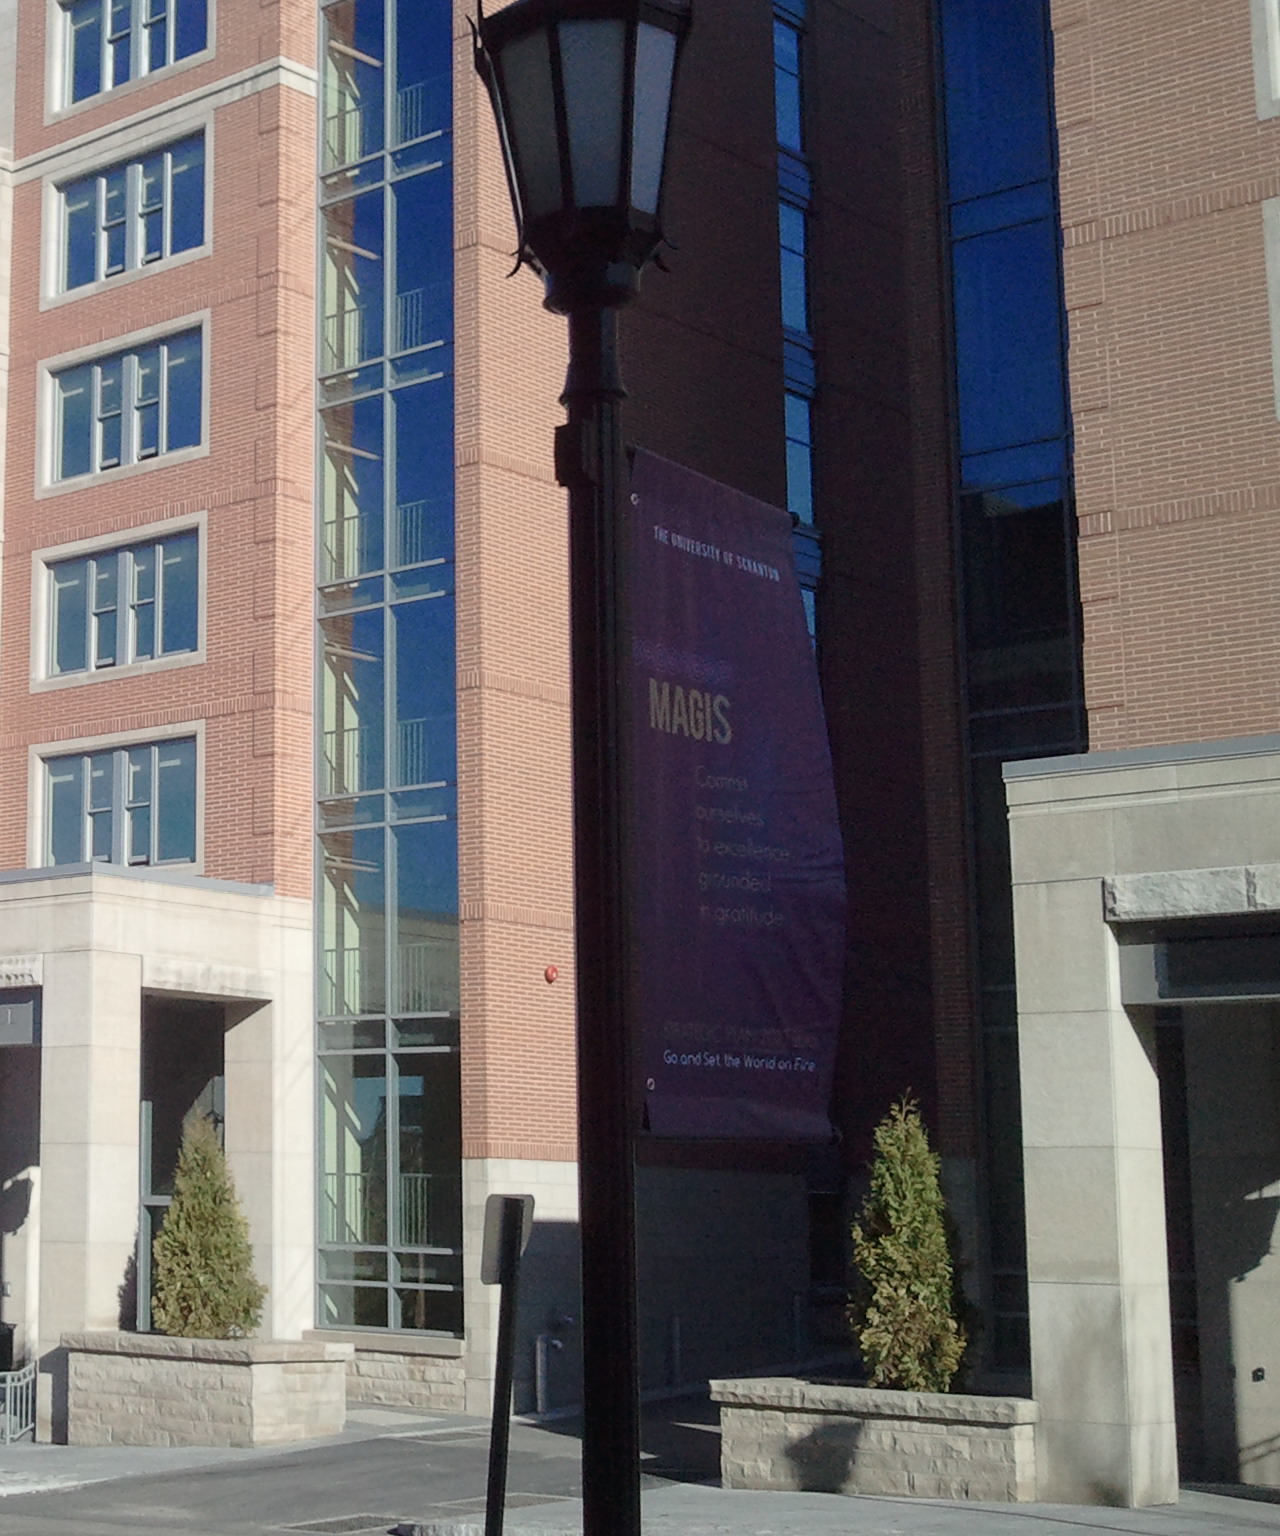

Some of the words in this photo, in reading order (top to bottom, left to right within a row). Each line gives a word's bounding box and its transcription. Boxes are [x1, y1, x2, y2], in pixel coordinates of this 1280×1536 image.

[654, 525, 668, 545] THE
[671, 532, 721, 562] UNIVERSITY
[723, 551, 734, 566] OF
[737, 555, 780, 582] SCRANTON
[649, 677, 733, 744] MAGIS
[663, 1049, 677, 1065] Go
[681, 1051, 702, 1066] and
[703, 1051, 721, 1067] Set
[724, 1053, 740, 1068] the
[743, 1054, 776, 1070] World
[778, 1060, 793, 1071] on
[794, 1056, 817, 1072] Fire
